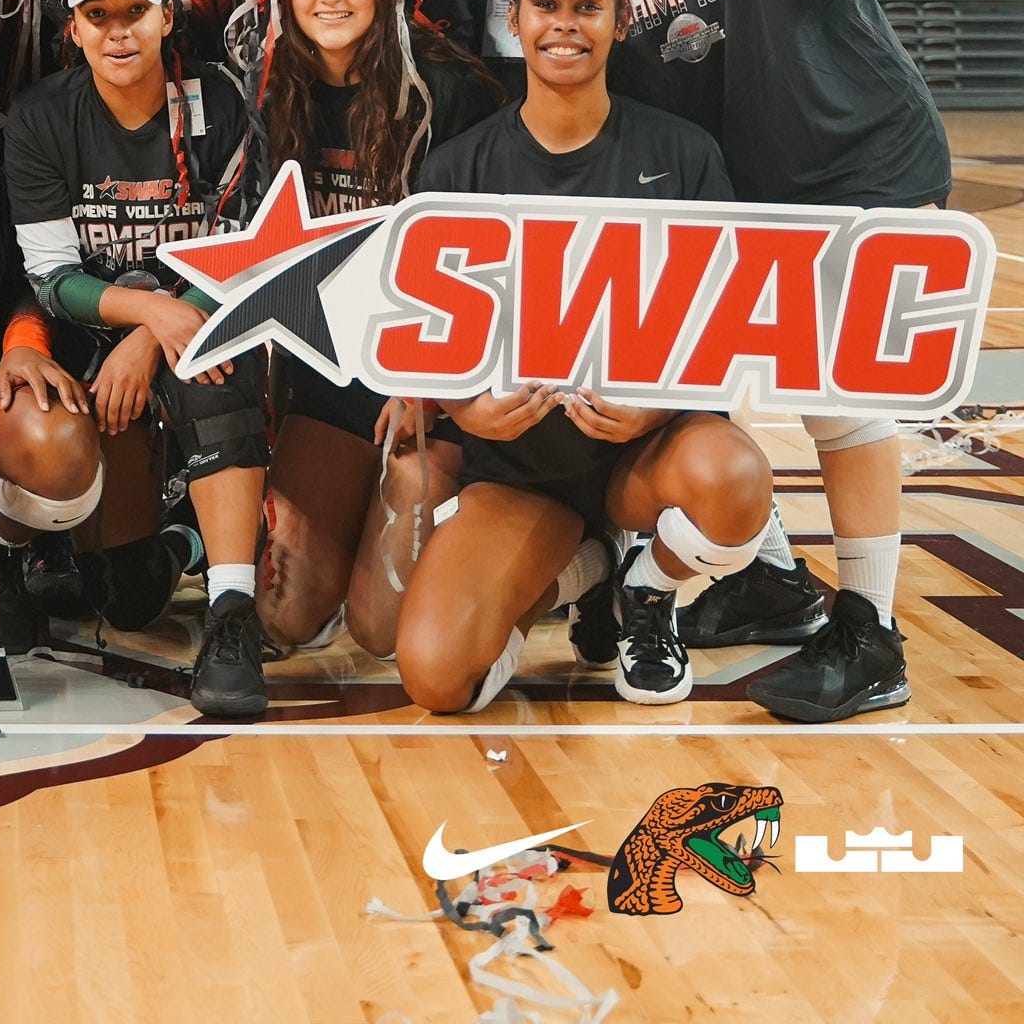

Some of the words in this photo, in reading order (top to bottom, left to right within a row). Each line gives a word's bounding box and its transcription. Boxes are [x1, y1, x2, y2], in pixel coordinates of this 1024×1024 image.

[82, 183, 95, 200] 20
[114, 178, 174, 202] SWAC
[72, 204, 118, 219] OMEN'S
[125, 202, 206, 219] VOLLEYBAL
[375, 215, 971, 396] SWAC
